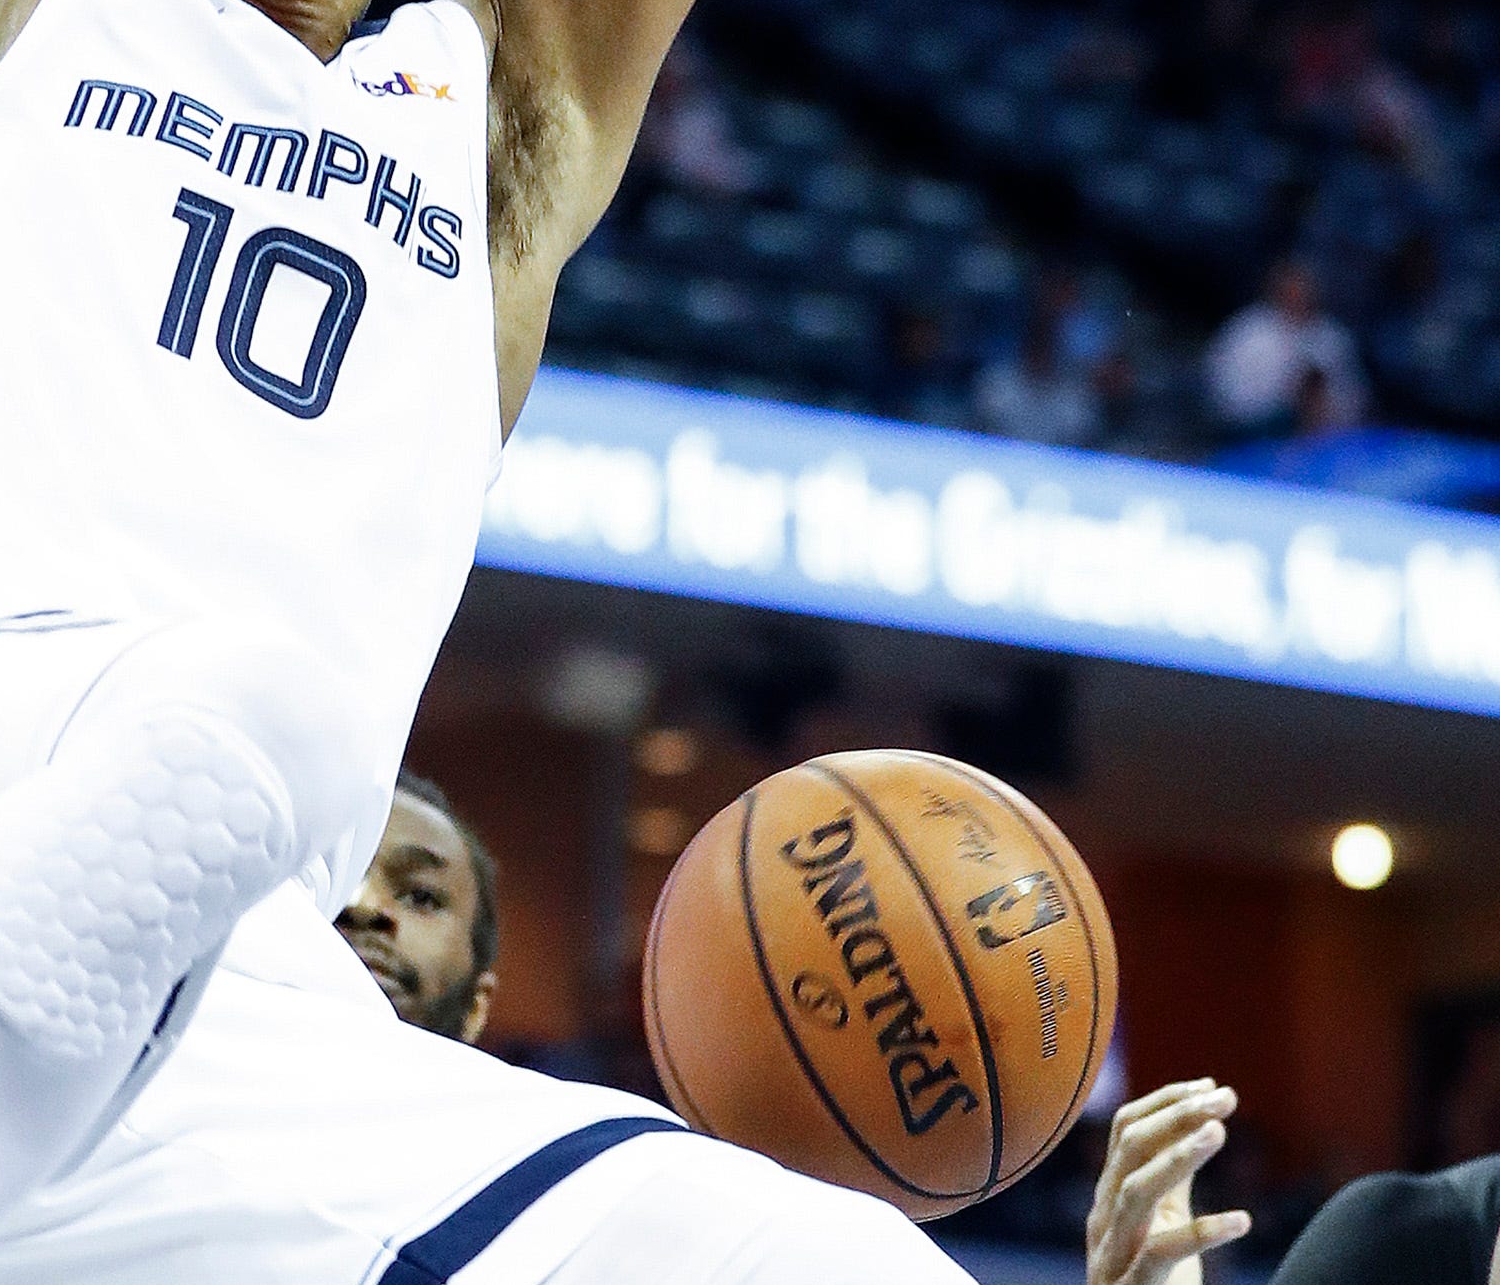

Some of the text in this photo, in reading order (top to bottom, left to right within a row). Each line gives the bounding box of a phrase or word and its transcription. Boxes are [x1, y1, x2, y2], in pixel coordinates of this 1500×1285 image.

[63, 78, 463, 279] MEMPHS
[155, 187, 368, 420] 10
[781, 806, 980, 1136] SPALDING
